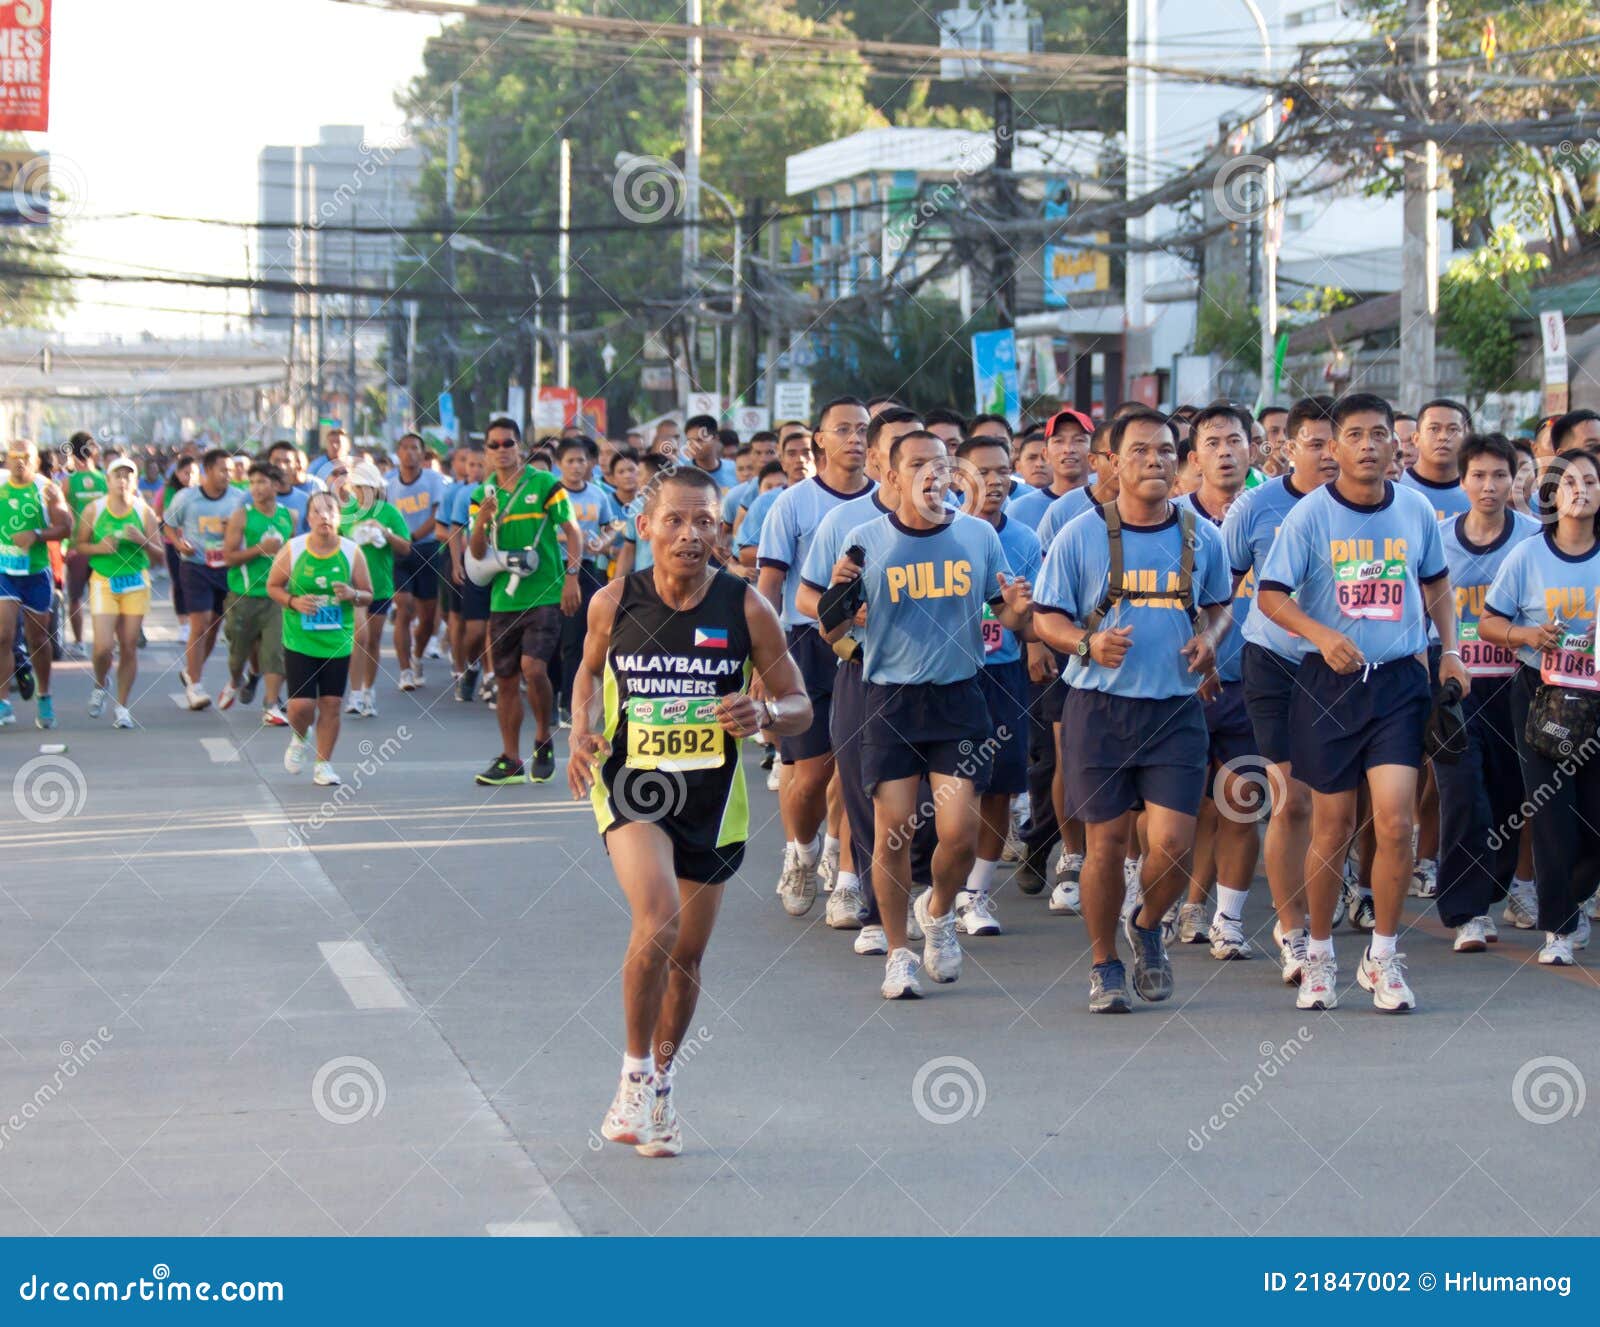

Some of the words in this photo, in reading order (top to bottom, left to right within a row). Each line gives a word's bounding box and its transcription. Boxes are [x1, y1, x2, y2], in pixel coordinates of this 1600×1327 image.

[1361, 565, 1382, 577] MILO
[886, 560, 972, 603] PULIS
[1339, 583, 1403, 606] 652130
[1565, 638, 1589, 649] MILO
[627, 677, 717, 695] RUNNERS
[663, 703, 686, 715] MILO
[637, 728, 715, 756] 25692
